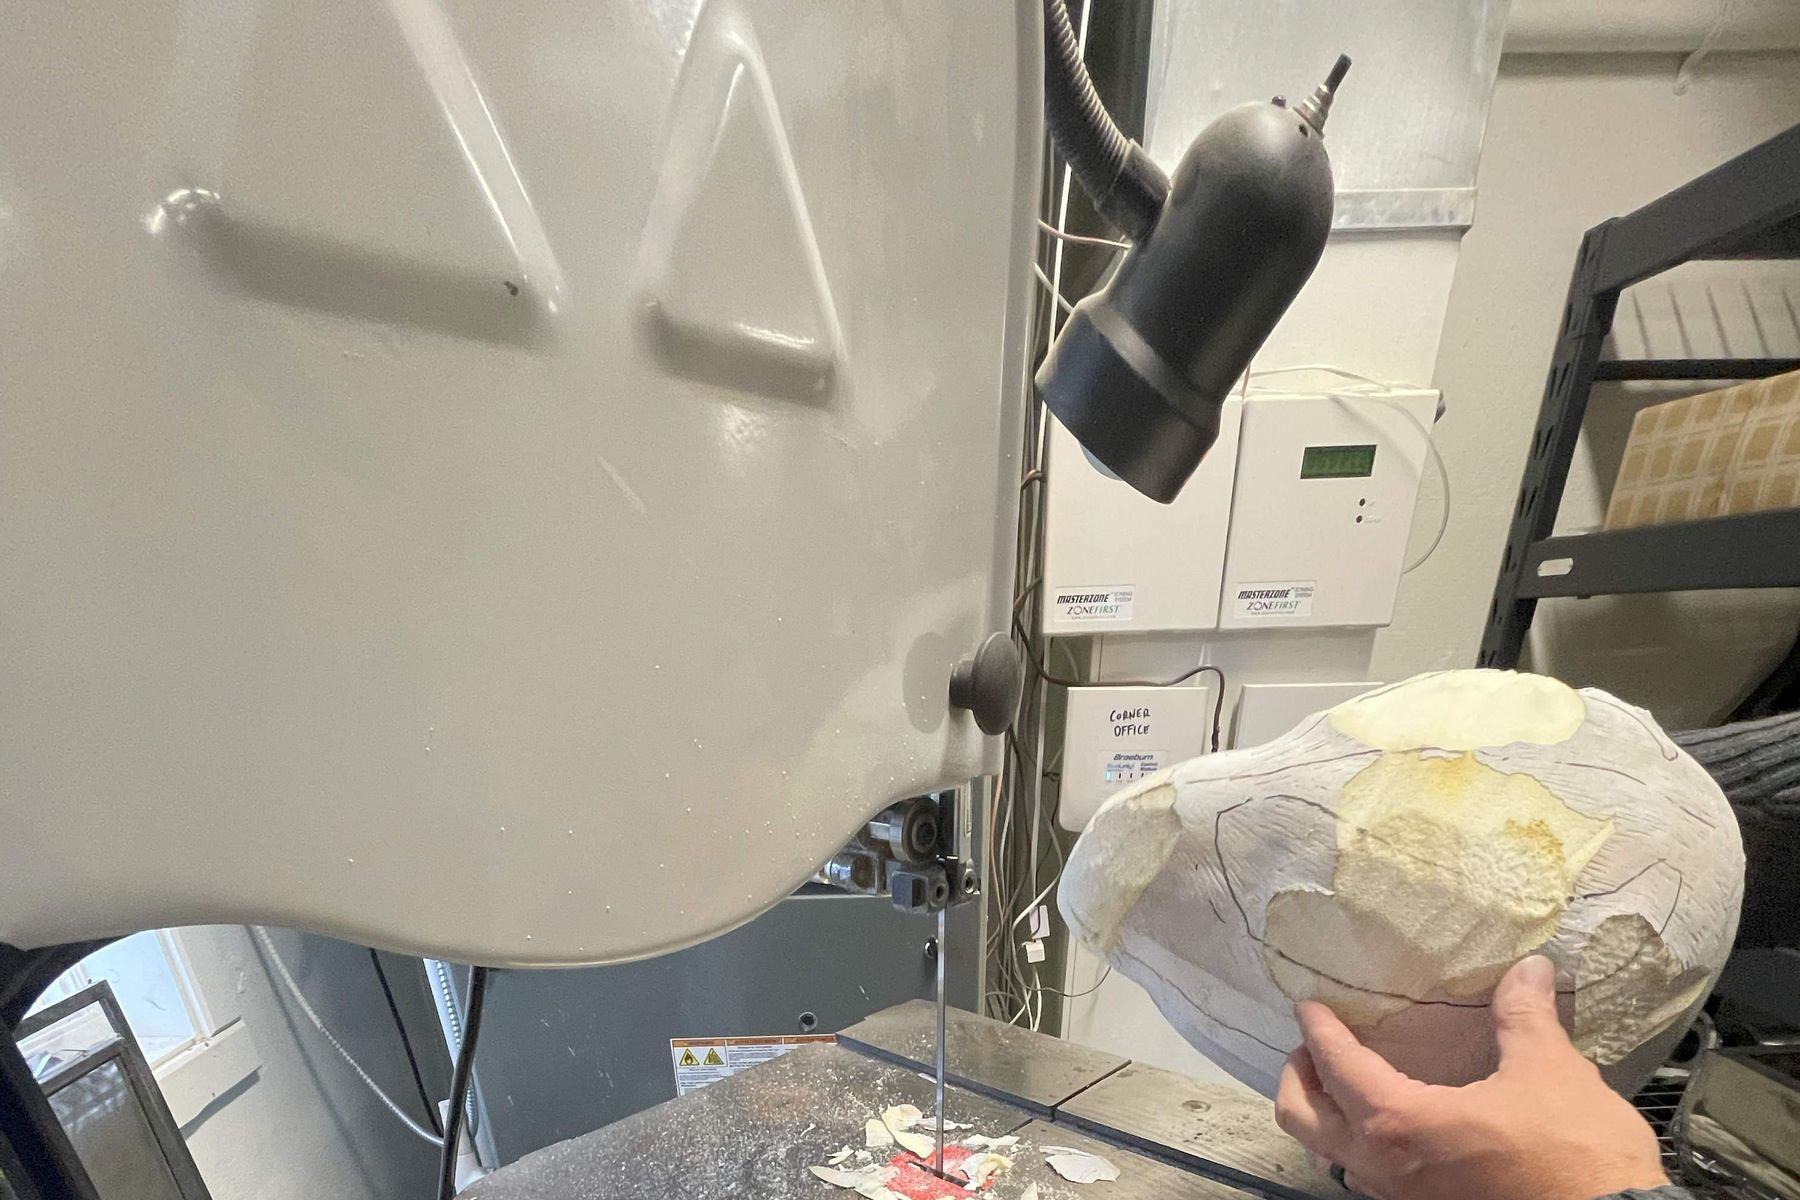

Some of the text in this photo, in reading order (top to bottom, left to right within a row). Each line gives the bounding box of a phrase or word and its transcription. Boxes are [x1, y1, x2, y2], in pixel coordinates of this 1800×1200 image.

[1057, 594, 1110, 604] MASTERZONE
[1237, 589, 1291, 600] MASTERZONE
[1066, 605, 1120, 615] ZONEFIRST
[1246, 601, 1300, 611] ZONEFIRST
[1109, 708, 1151, 722] CORNER
[1114, 724, 1150, 737] OFFICE
